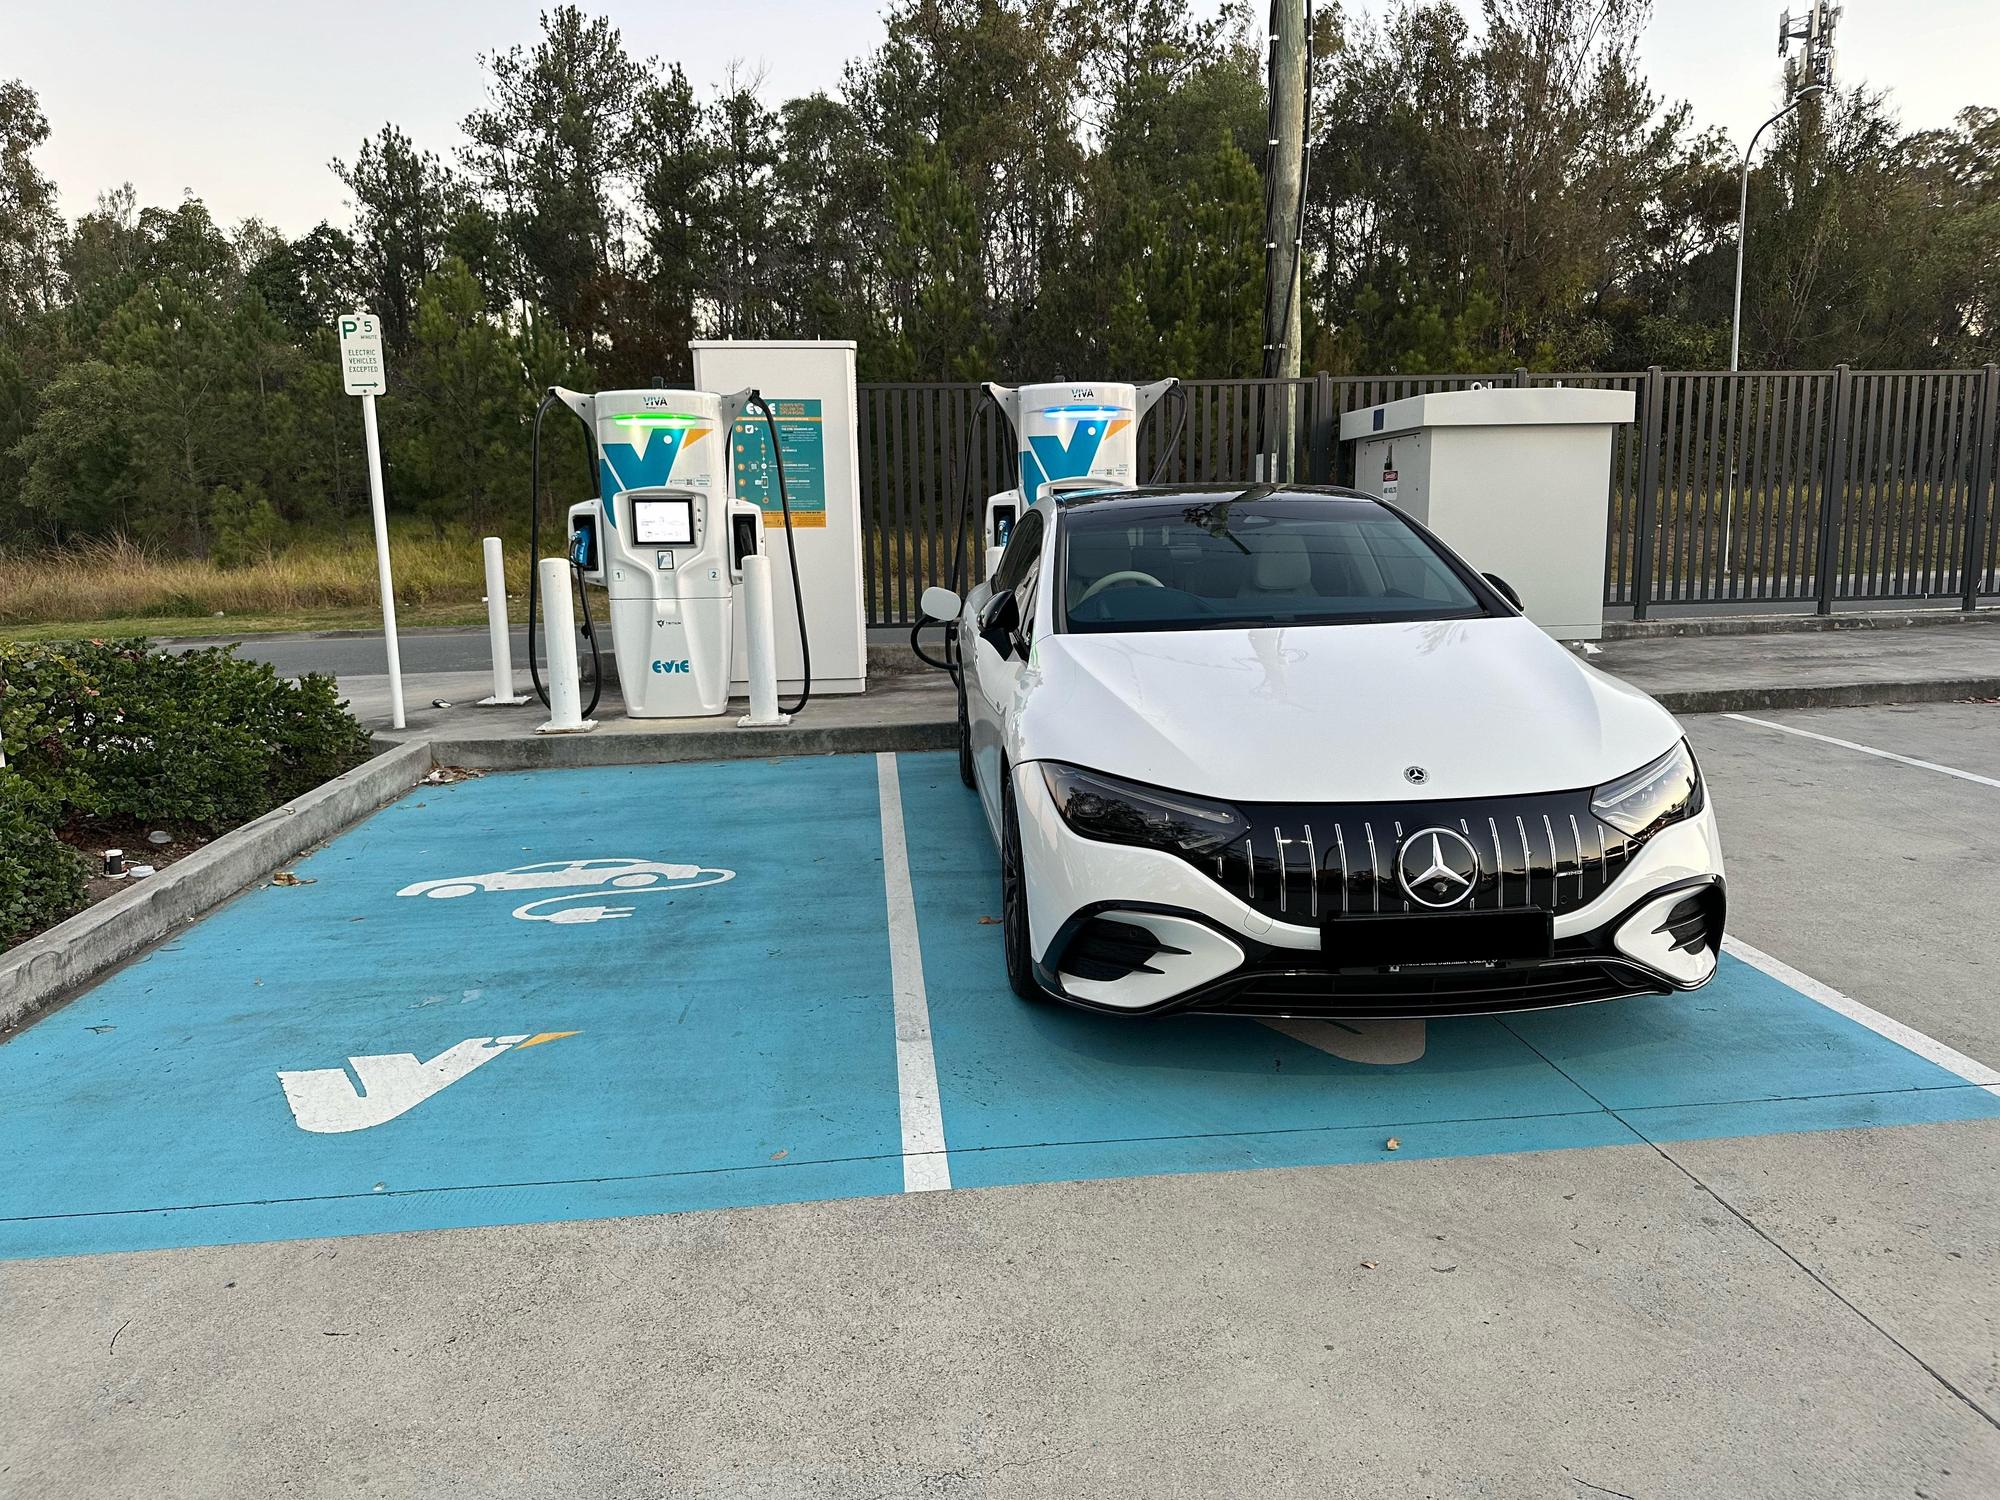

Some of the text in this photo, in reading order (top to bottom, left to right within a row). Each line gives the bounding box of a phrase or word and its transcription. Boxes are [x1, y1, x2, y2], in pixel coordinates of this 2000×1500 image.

[342, 321, 373, 339] P 5
[1071, 388, 1094, 398] VIVA
[643, 396, 668, 406] VIVA
[616, 571, 621, 579] 1
[711, 571, 717, 579] 2
